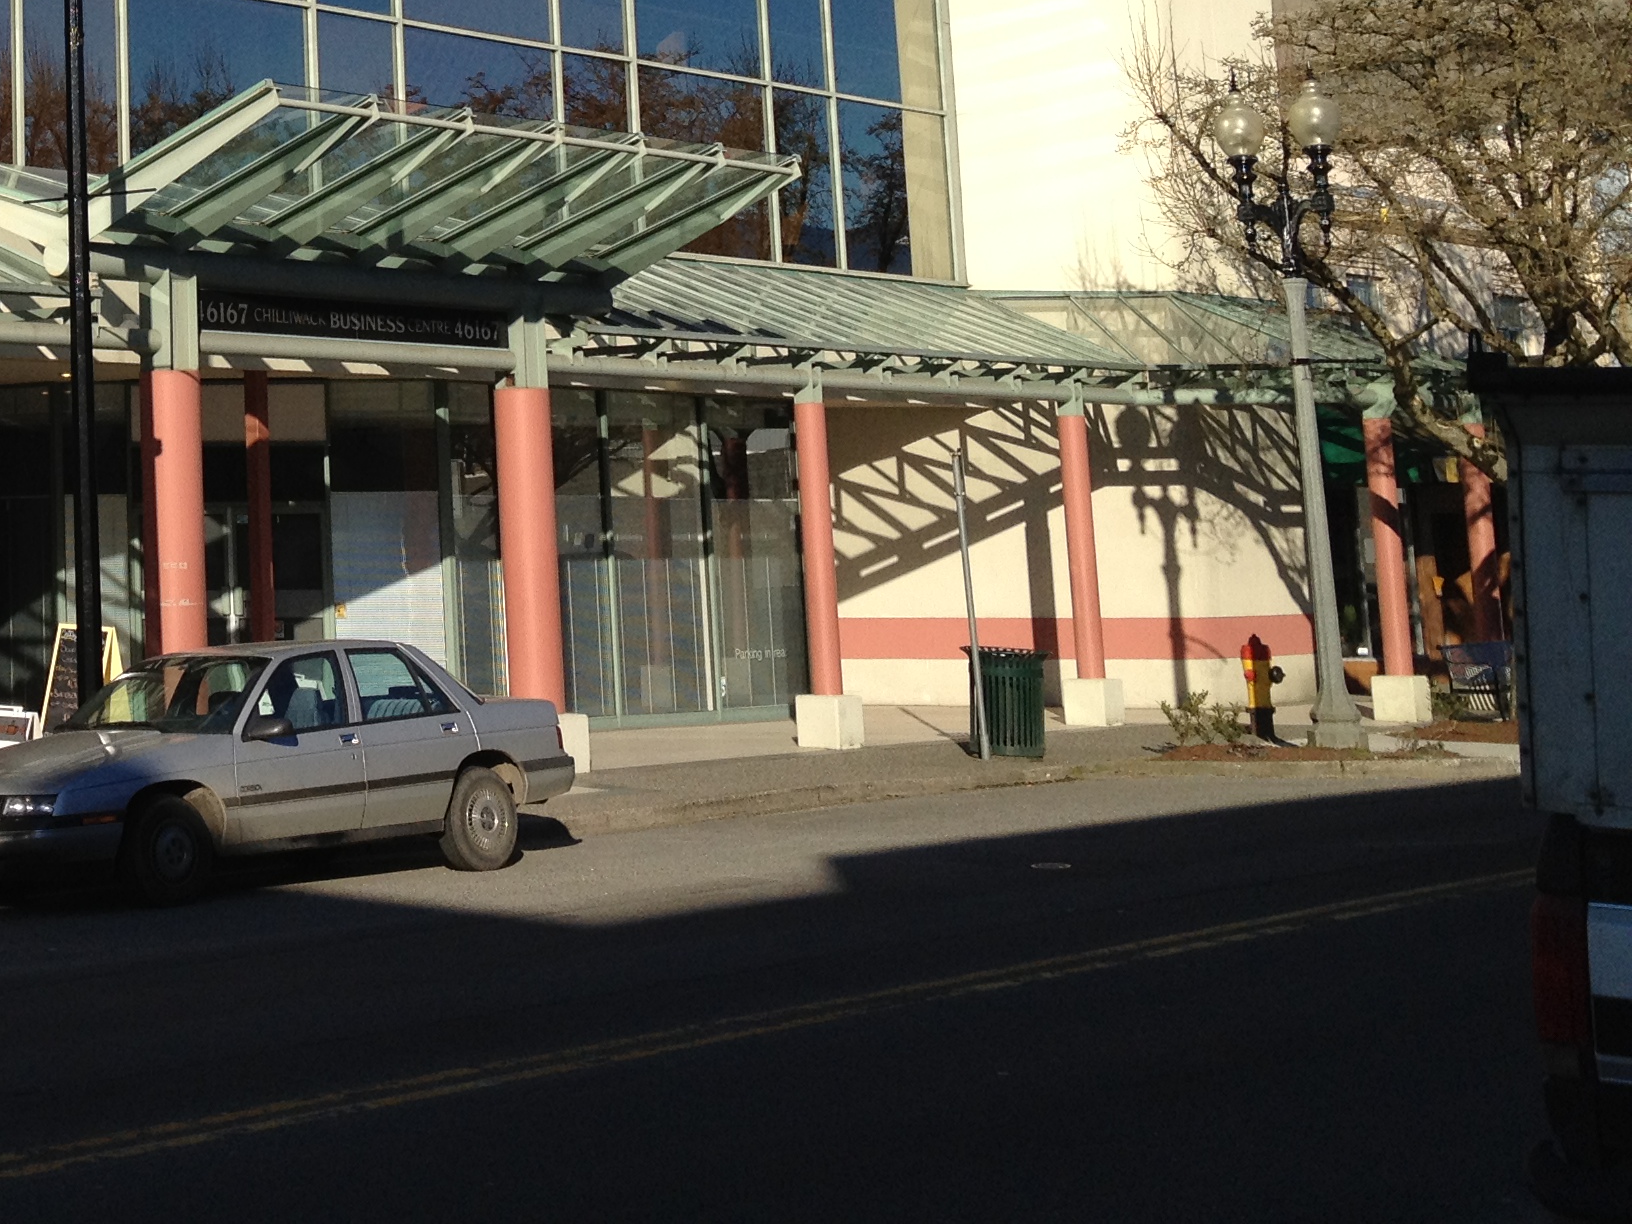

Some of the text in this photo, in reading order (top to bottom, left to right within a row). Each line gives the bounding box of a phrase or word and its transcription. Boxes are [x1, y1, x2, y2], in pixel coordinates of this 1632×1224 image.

[254, 307, 326, 326] CHILLIWACK
[330, 311, 405, 334] BUSINESS
[408, 318, 451, 335] CENTRE
[454, 319, 499, 341] 46167
[735, 648, 763, 661] Parking
[765, 646, 771, 658] in
